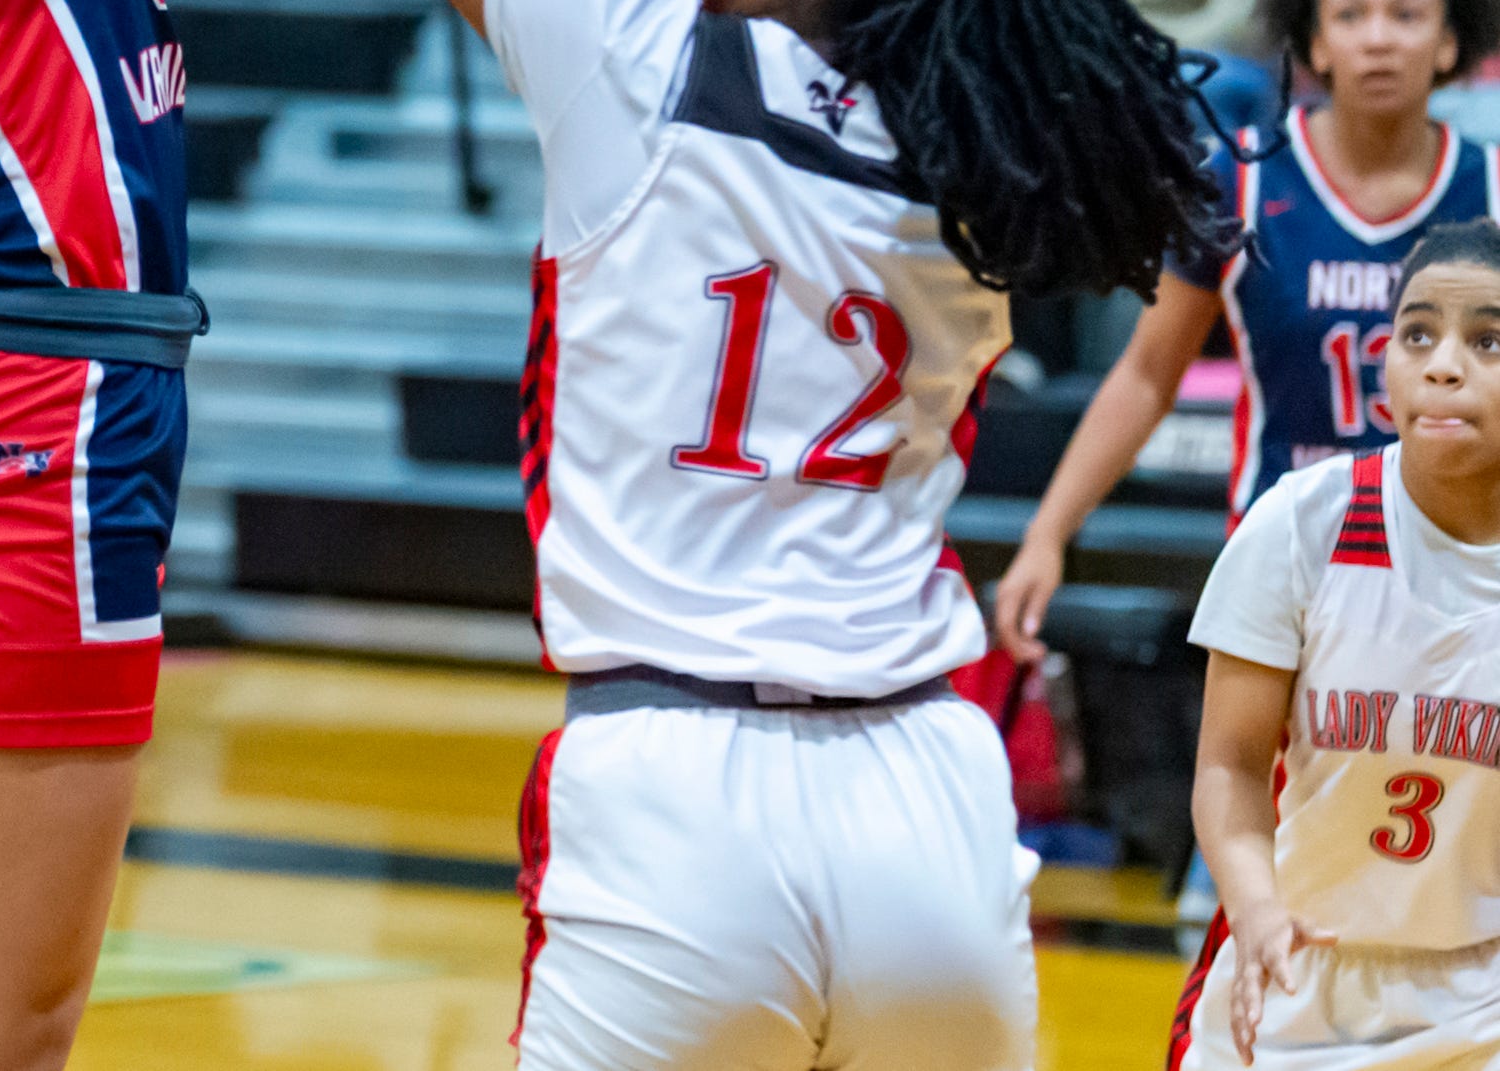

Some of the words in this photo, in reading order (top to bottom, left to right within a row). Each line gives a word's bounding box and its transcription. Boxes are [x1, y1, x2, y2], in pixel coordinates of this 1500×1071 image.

[669, 259, 912, 492] 12
[1307, 689, 1399, 754] LADY
[1368, 771, 1445, 864] 3
